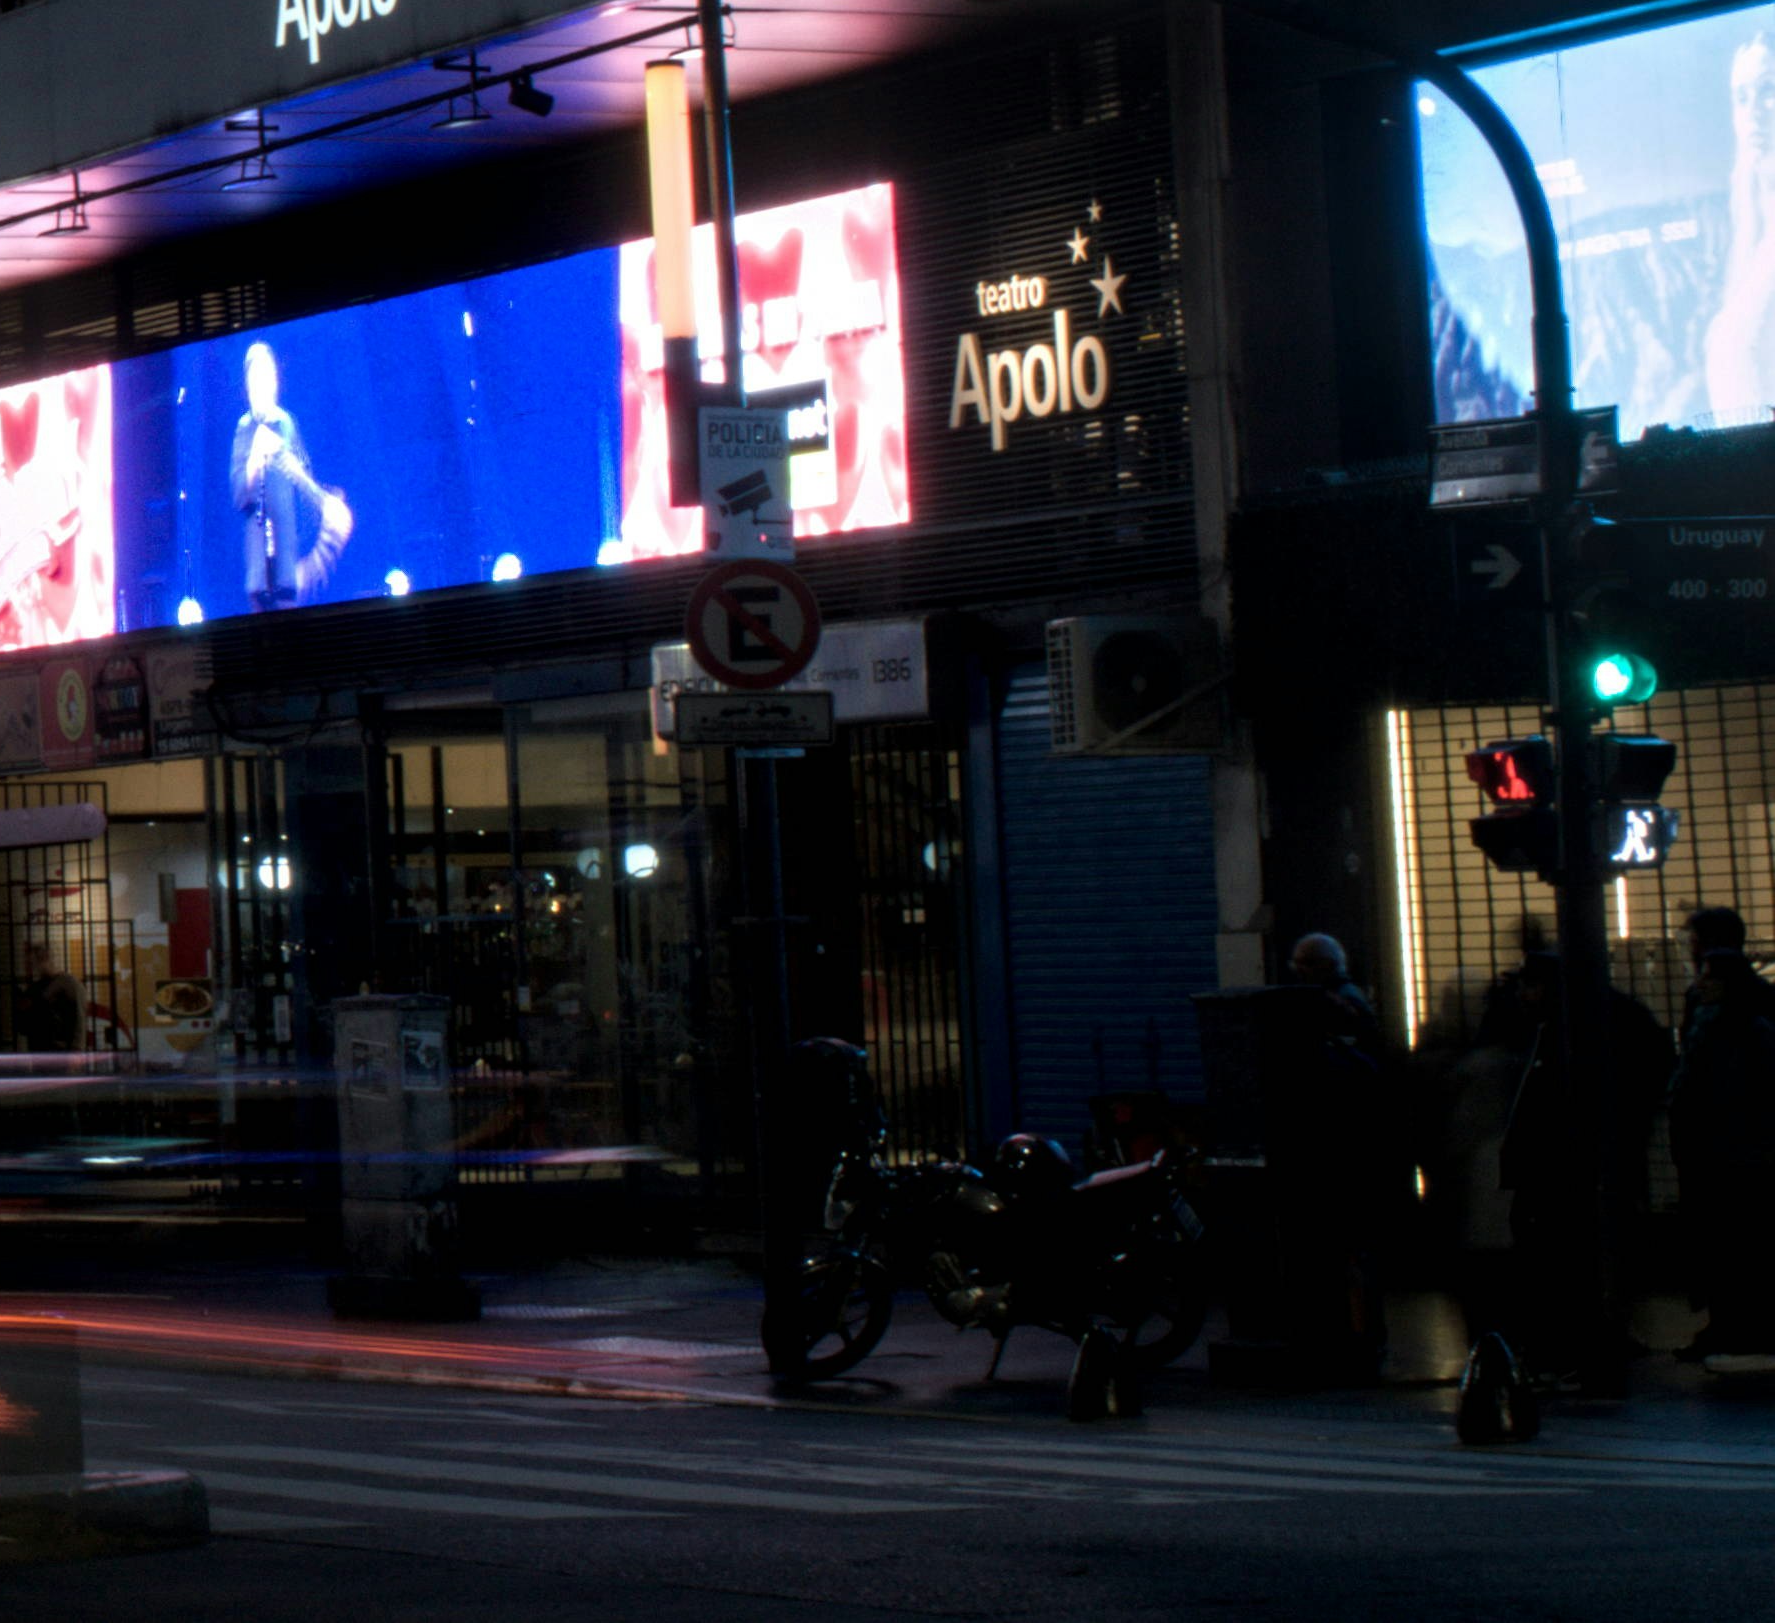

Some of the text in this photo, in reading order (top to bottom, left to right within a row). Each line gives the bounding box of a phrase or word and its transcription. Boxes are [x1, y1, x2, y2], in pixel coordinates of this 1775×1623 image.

[975, 274, 1048, 318] teatro
[948, 308, 1114, 452] Apolo
[1667, 528, 1766, 549] Uruguay
[1667, 578, 1707, 600] 400
[1727, 577, 1768, 599] 300
[728, 586, 781, 662] E
